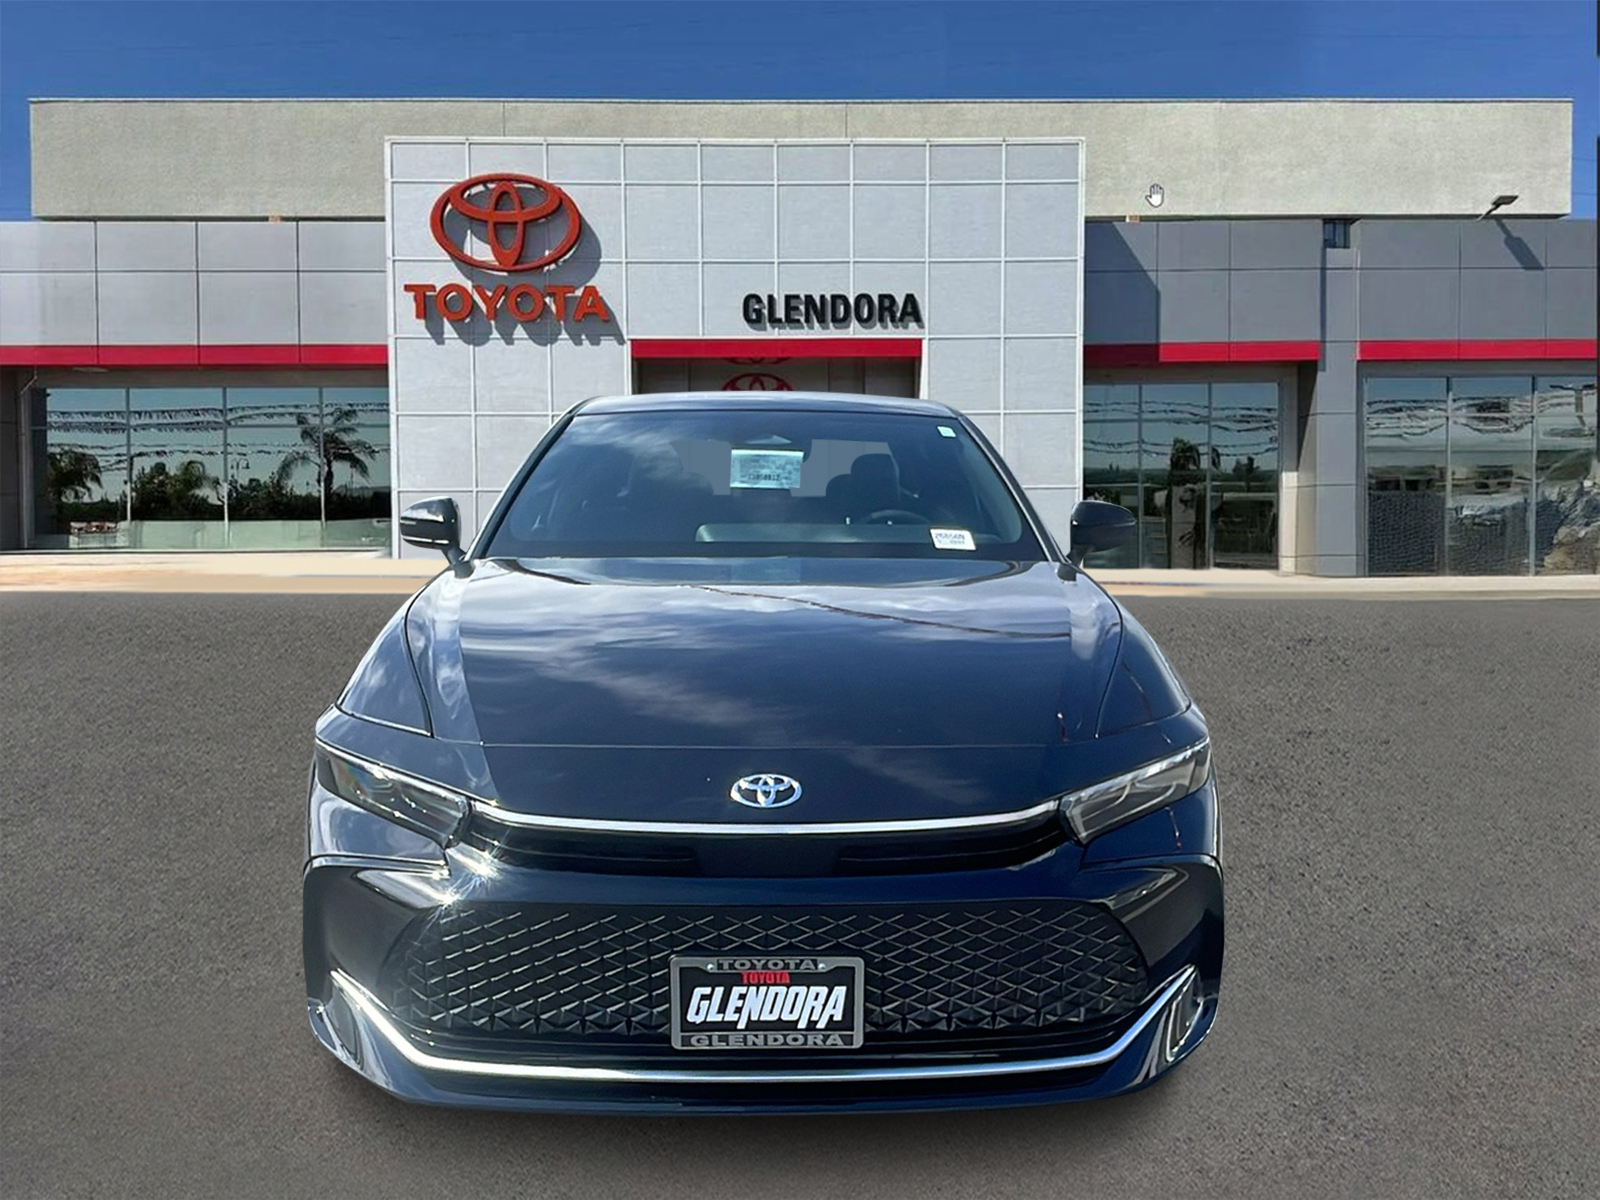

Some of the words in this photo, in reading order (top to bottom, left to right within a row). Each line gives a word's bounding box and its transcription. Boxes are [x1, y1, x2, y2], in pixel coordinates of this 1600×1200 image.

[404, 283, 610, 323] TOYOTA
[743, 293, 922, 324] GLENDORA
[718, 959, 815, 970] TOYOTA
[741, 972, 790, 984] TOYOTA
[686, 986, 847, 1029] GLENDORA
[690, 1034, 844, 1047] GLENDORA
